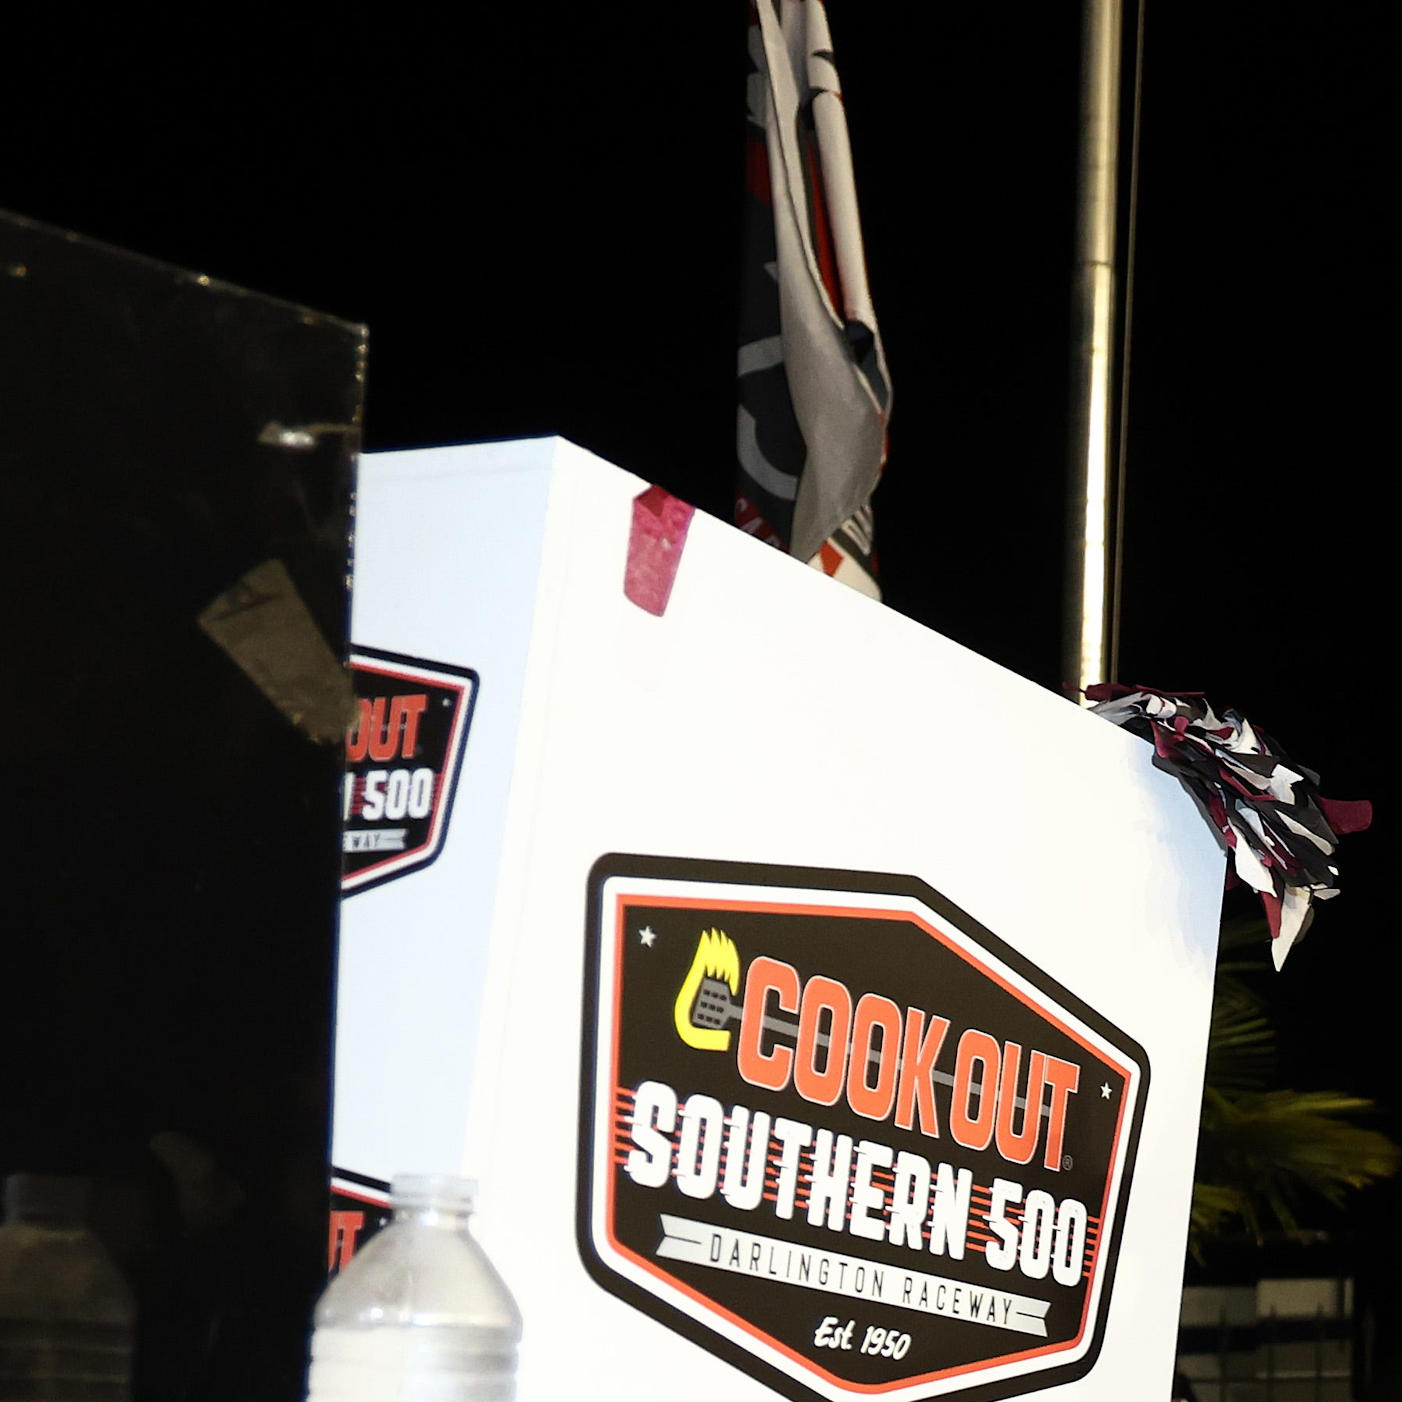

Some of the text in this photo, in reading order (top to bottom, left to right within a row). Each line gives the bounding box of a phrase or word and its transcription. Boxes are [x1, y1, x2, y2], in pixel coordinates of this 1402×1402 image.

[361, 767, 434, 821] 500
[624, 1080, 1089, 1288] SOUTHERN 500
[709, 1232, 1014, 1326] DARLINGTON RACEWAY
[813, 1316, 913, 1361] Est. 1950
